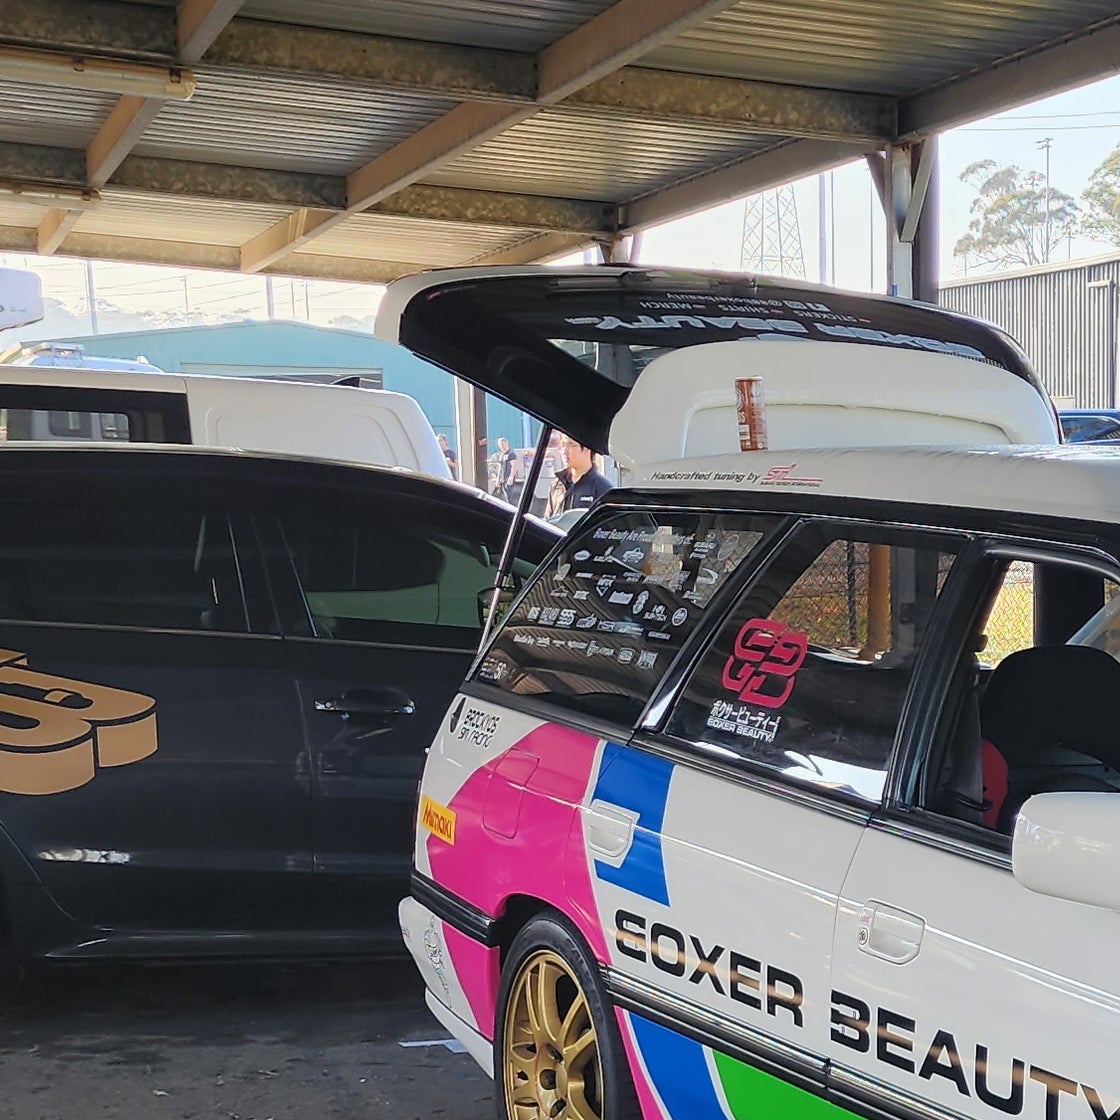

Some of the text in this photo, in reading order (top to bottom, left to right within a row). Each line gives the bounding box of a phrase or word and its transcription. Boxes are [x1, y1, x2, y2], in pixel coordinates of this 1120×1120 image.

[640, 301, 859, 323] STICKERS SHIRTS MERCH
[651, 471, 711, 481] Handcrafted
[714, 472, 745, 482] tuning
[747, 470, 761, 483] by
[736, 725, 774, 742] BEAUTY
